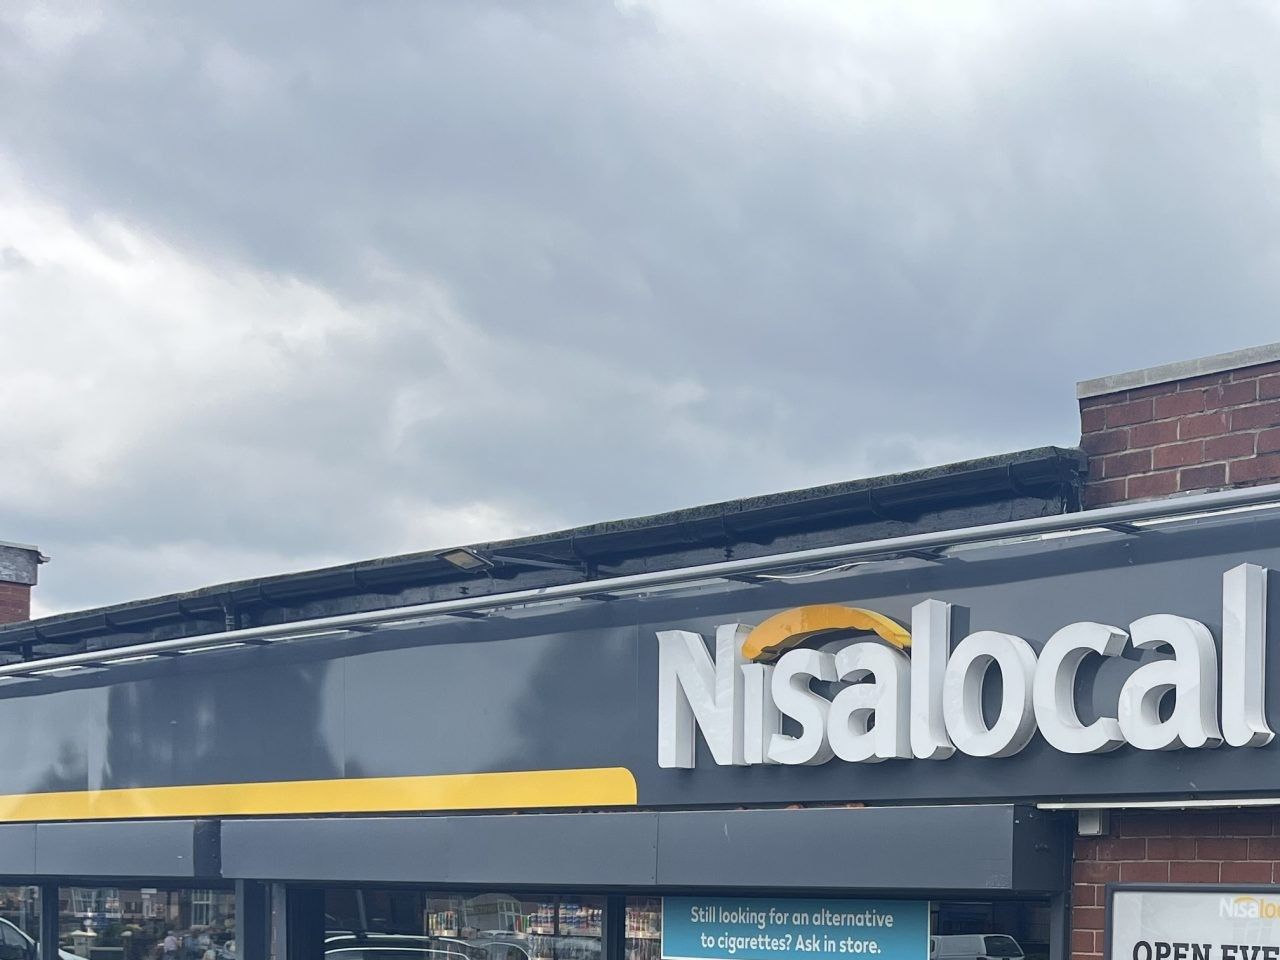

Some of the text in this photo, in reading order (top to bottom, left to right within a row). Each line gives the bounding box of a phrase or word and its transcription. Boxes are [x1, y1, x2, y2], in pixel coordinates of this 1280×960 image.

[690, 906, 894, 930] Still looking for an alternative
[700, 932, 881, 954] to cigarettes? Ask in store.
